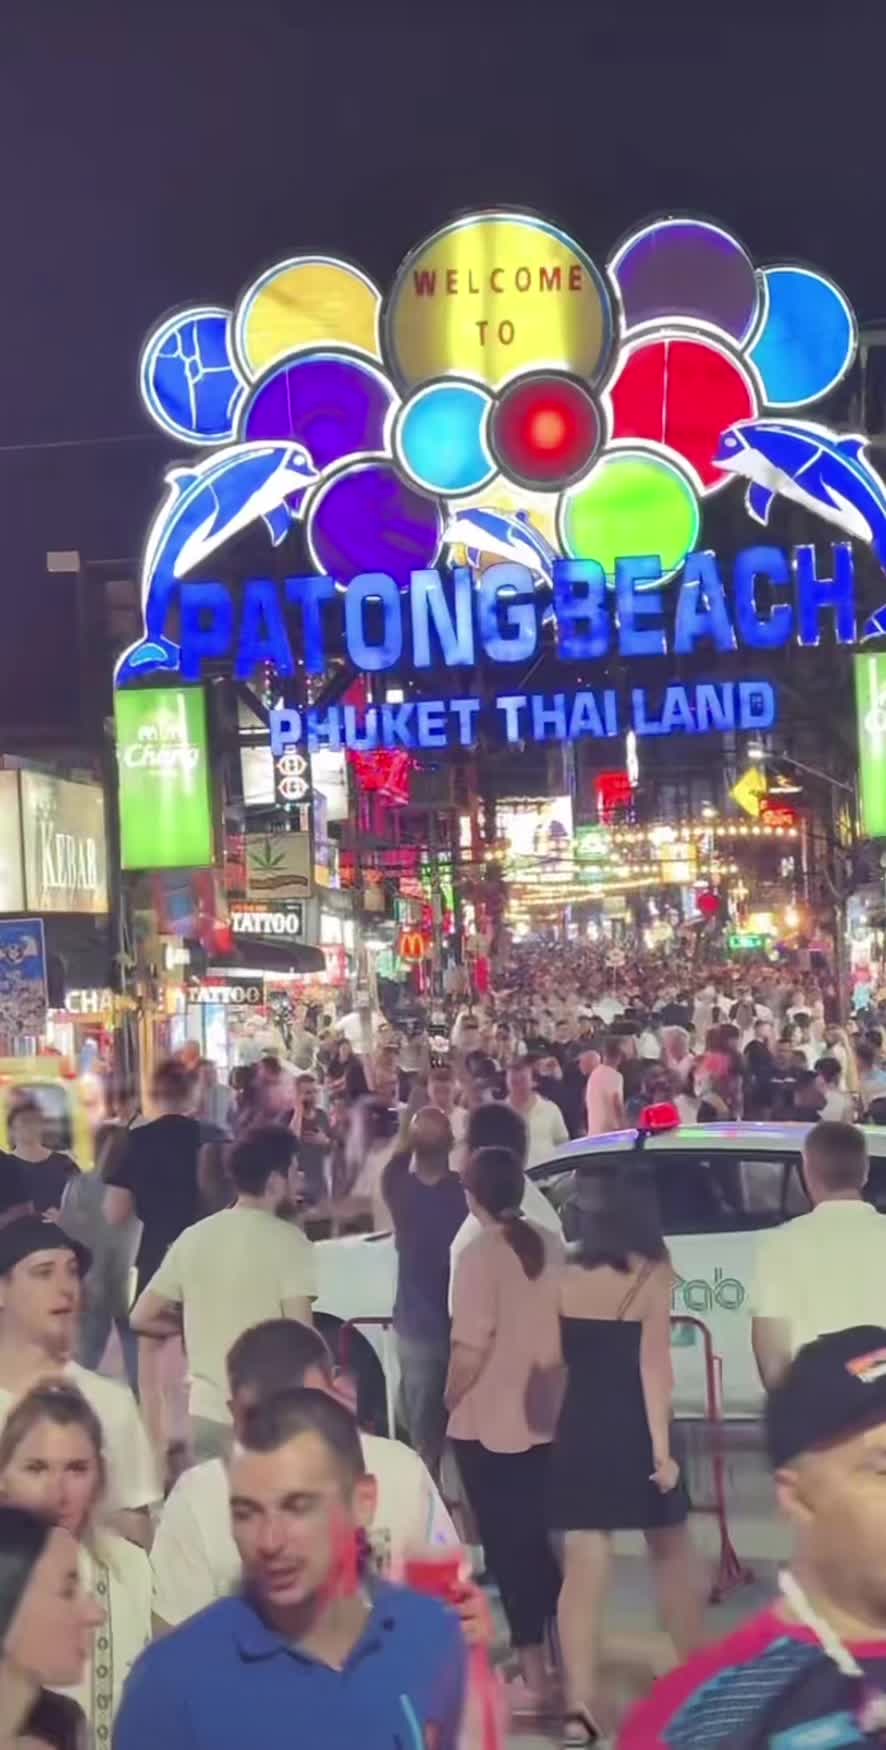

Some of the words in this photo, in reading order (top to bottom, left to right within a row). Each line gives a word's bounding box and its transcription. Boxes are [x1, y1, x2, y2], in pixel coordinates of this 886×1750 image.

[414, 264, 582, 297] WELCOME
[475, 319, 515, 346] TO
[180, 562, 538, 682] PATONG
[553, 542, 858, 662] BEACH
[269, 698, 480, 756] PHUKET
[123, 744, 199, 768] Chang
[40, 821, 97, 888] KEBAB
[231, 911, 299, 933] TATTOO
[64, 989, 113, 1013] CHA
[186, 985, 260, 1003] TATTOO
[671, 1267, 745, 1312] rab
